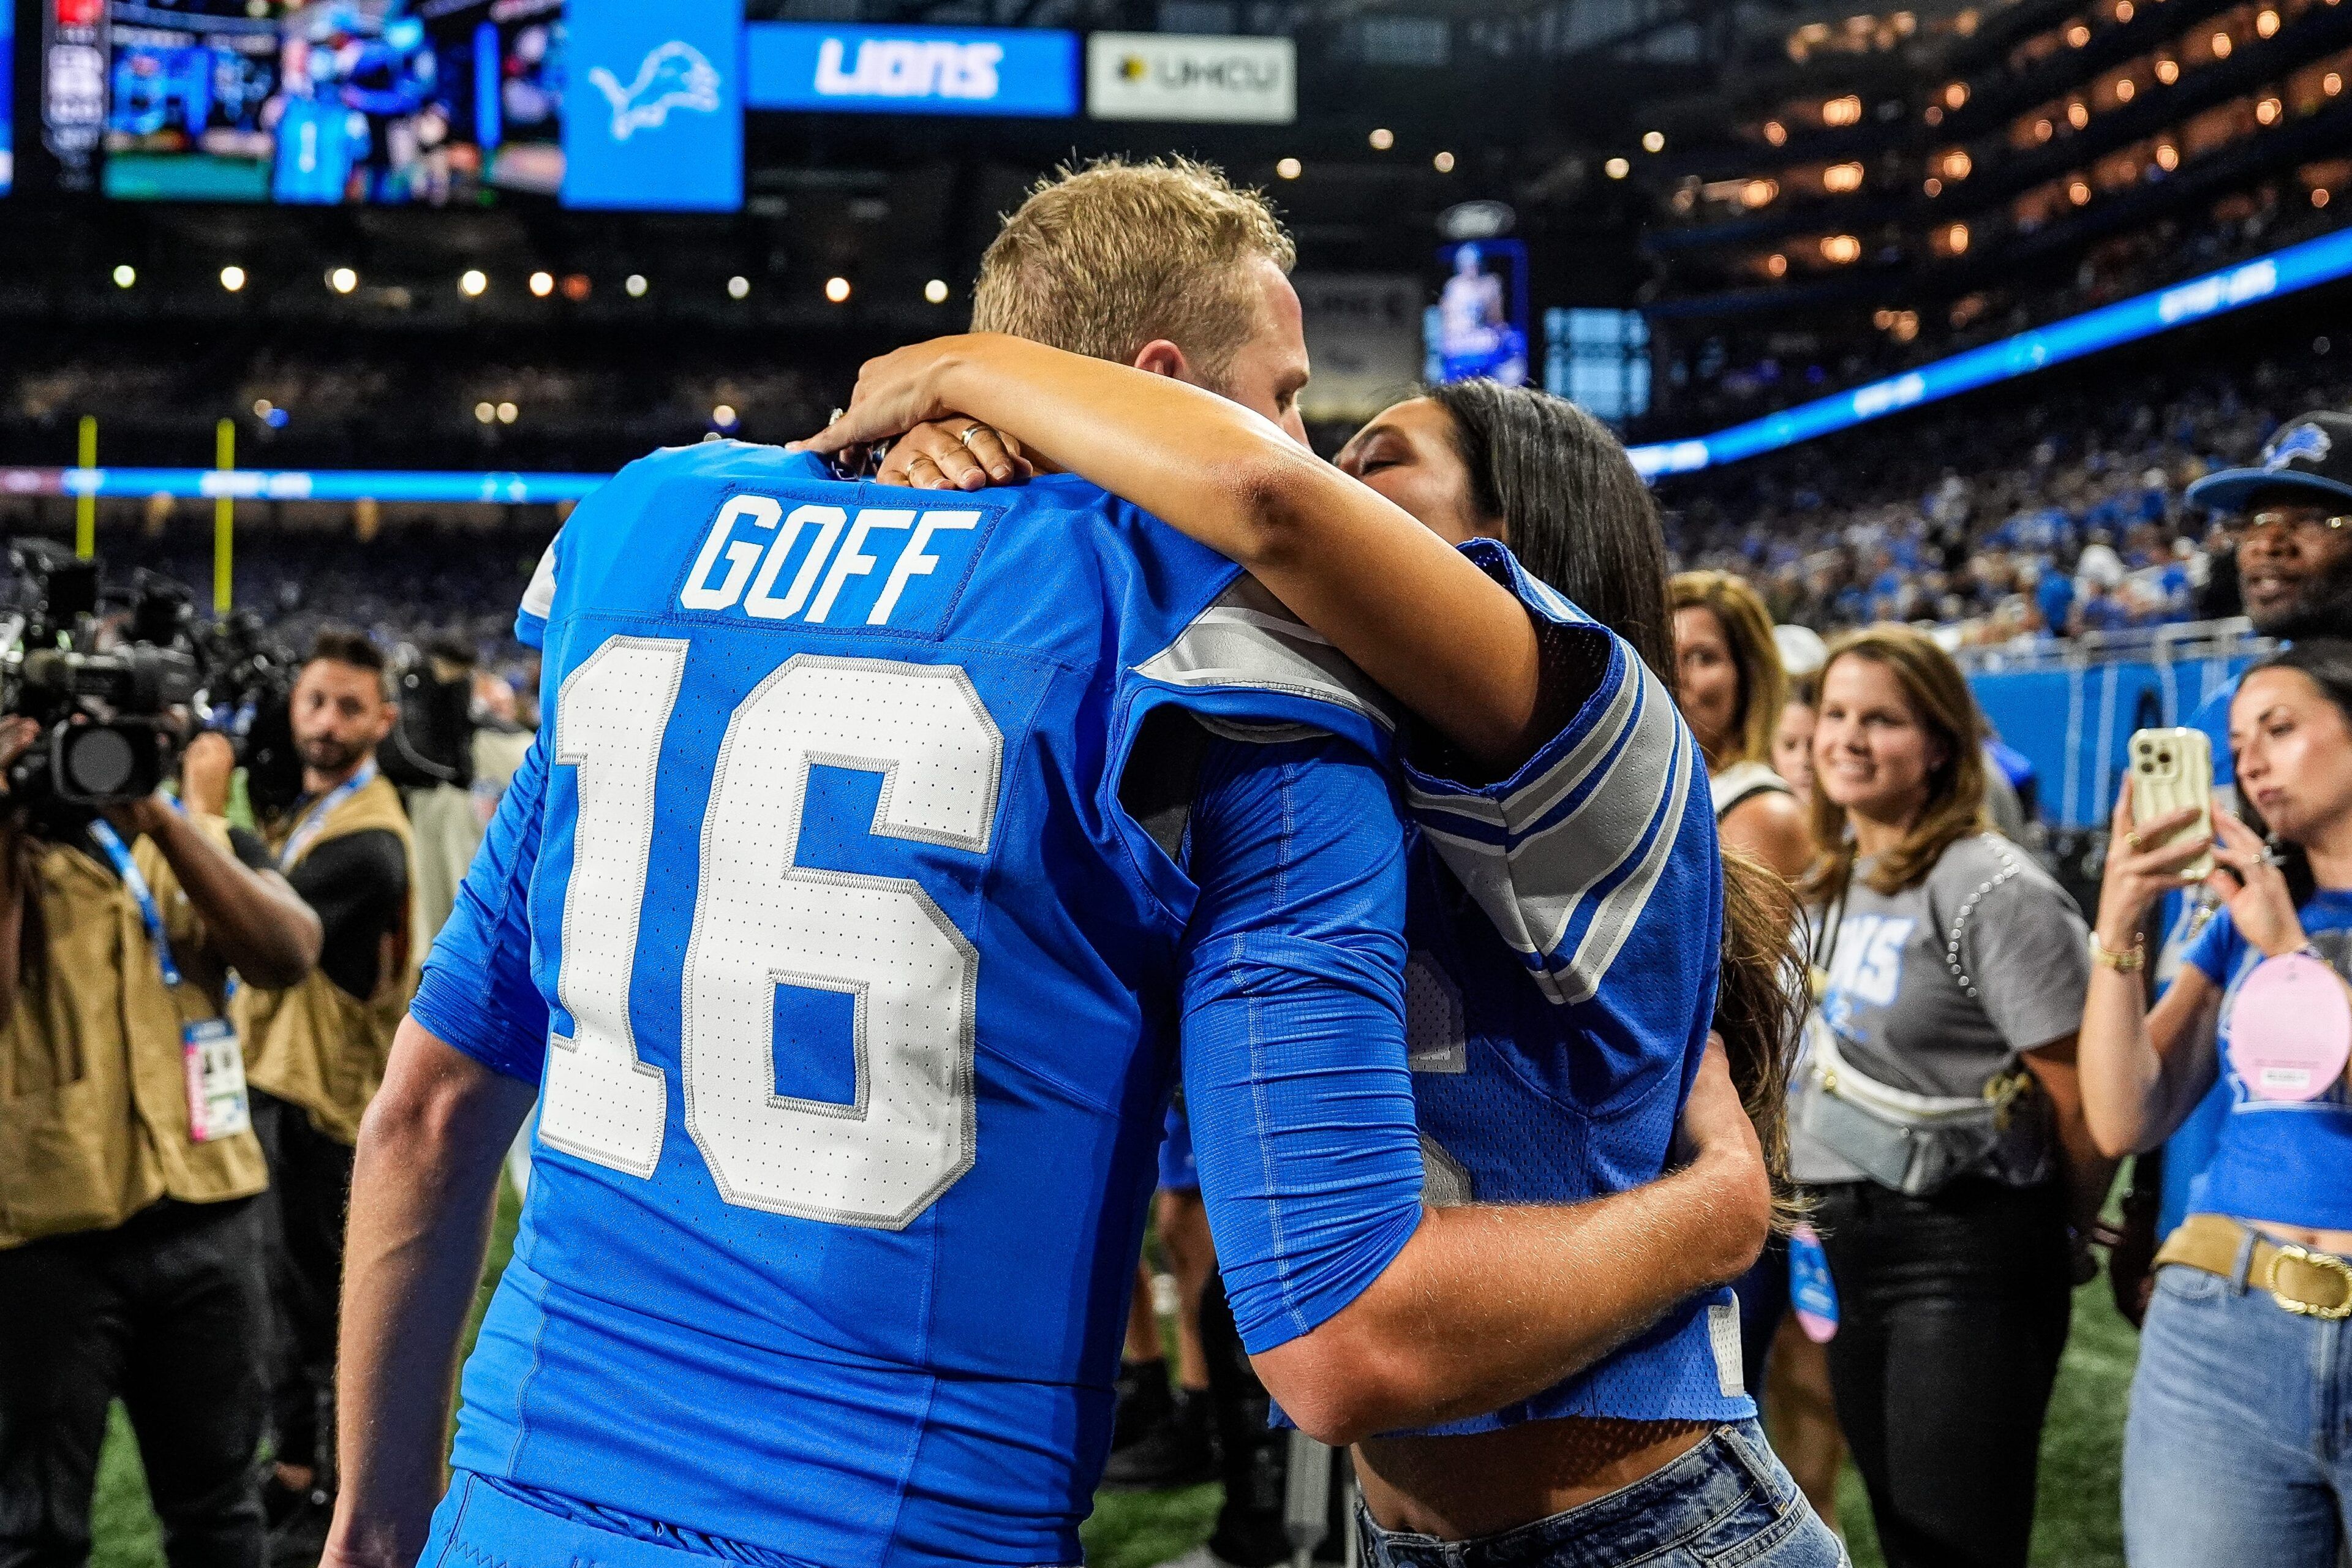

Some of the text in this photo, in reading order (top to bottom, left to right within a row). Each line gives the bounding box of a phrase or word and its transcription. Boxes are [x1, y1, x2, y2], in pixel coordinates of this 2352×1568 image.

[813, 38, 1003, 98] LIONS
[680, 494, 982, 625] GOFF
[539, 633, 1004, 1231] 16
